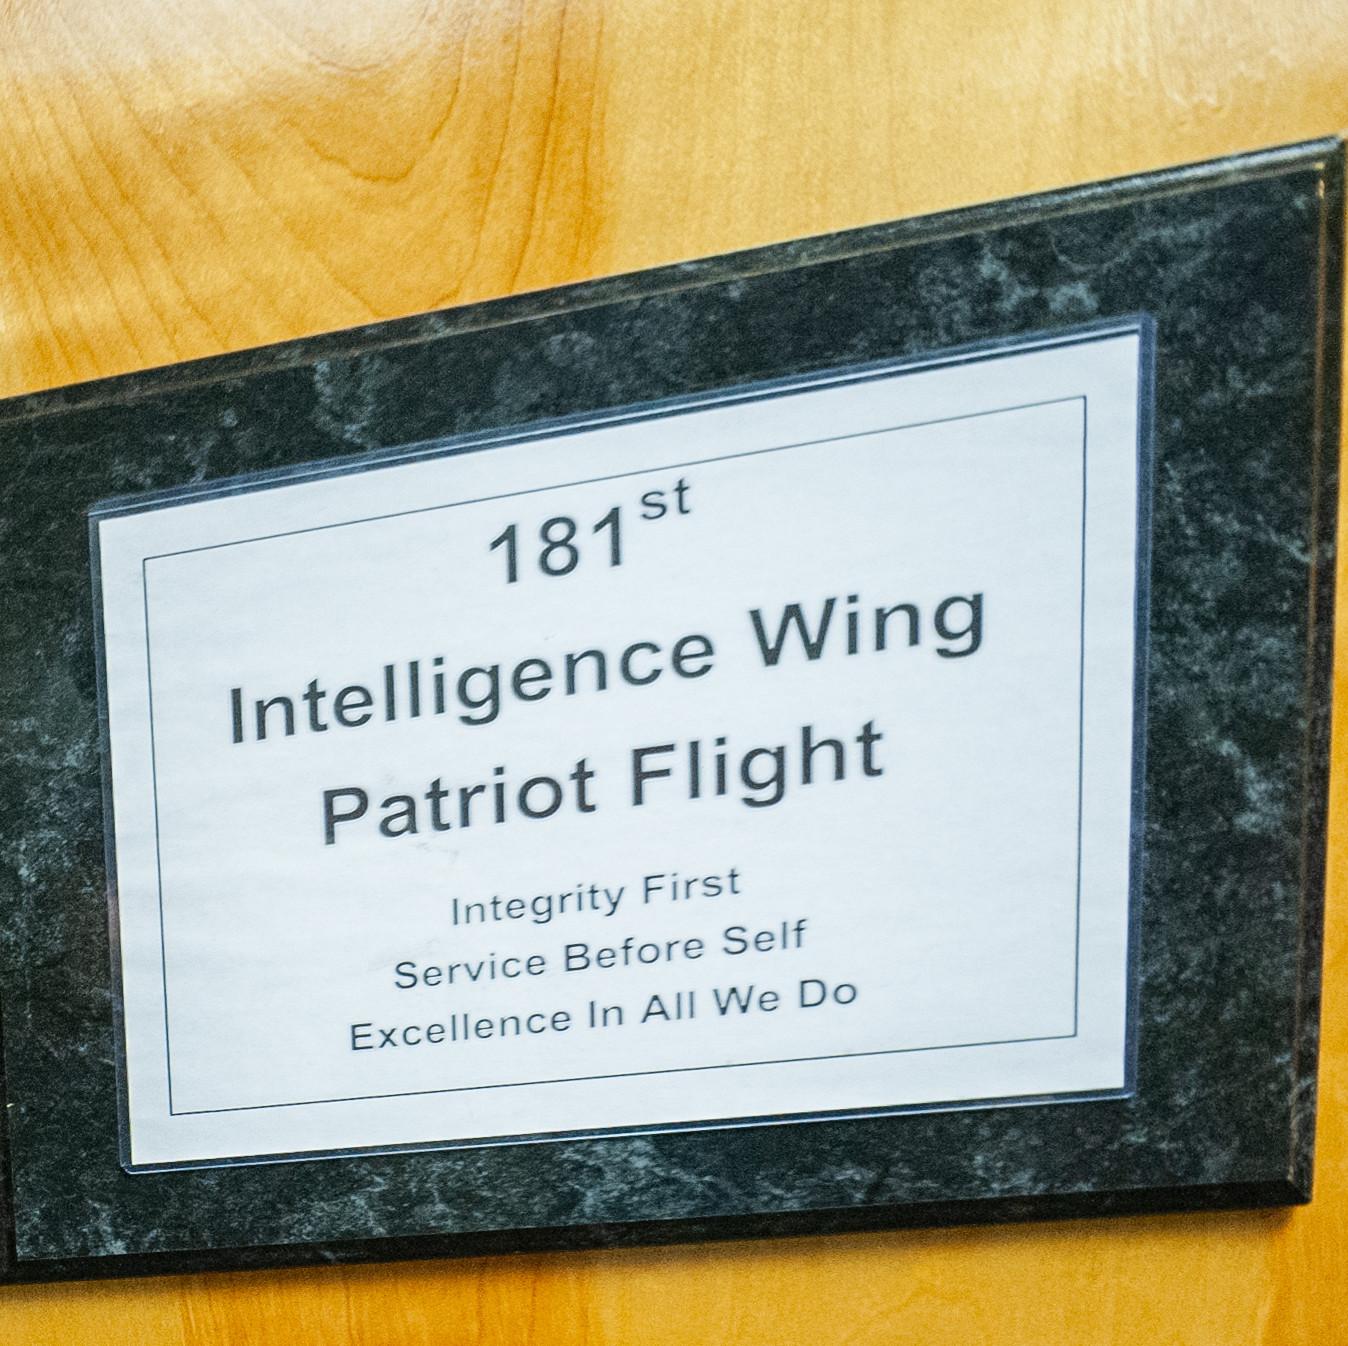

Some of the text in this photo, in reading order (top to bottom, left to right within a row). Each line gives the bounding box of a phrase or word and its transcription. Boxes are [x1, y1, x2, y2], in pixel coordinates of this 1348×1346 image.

[488, 478, 693, 585] 181st
[229, 591, 986, 746] Intelligence Wing
[321, 718, 885, 847] Patriot Flight
[451, 867, 742, 927] Integrity First
[393, 917, 808, 991] Service Before Self
[349, 977, 859, 1052] Excellence In All We Do
